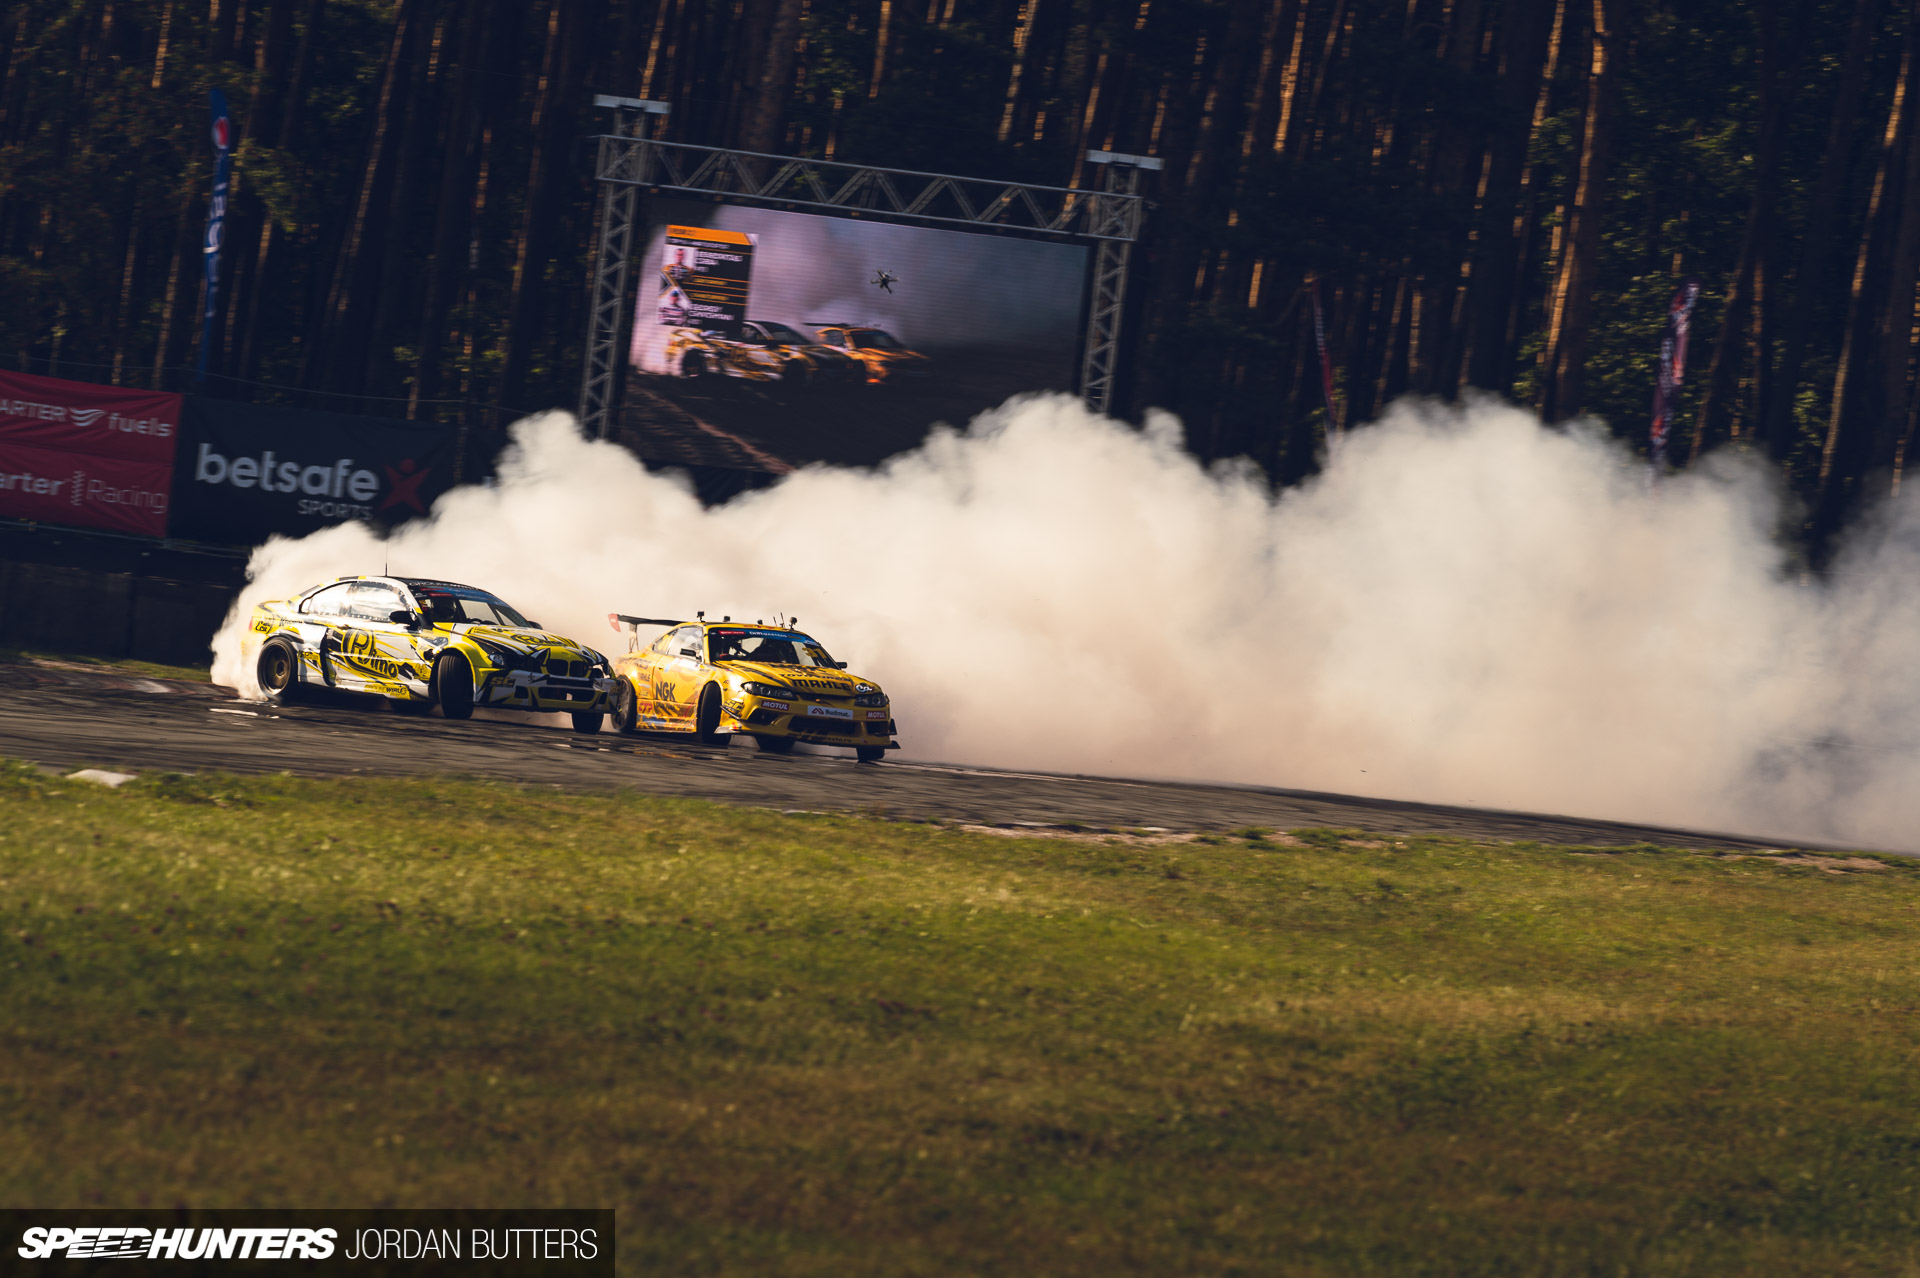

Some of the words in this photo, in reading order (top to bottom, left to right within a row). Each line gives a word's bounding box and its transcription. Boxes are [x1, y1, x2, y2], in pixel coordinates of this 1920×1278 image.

[108, 412, 174, 437] fuels
[195, 443, 379, 501] betsafe
[86, 479, 168, 514] Racing
[297, 499, 374, 521] SPORTS
[802, 647, 828, 658] 31
[655, 681, 676, 702] NGK
[792, 680, 852, 691] MAHLE
[762, 701, 789, 710] MOTUL
